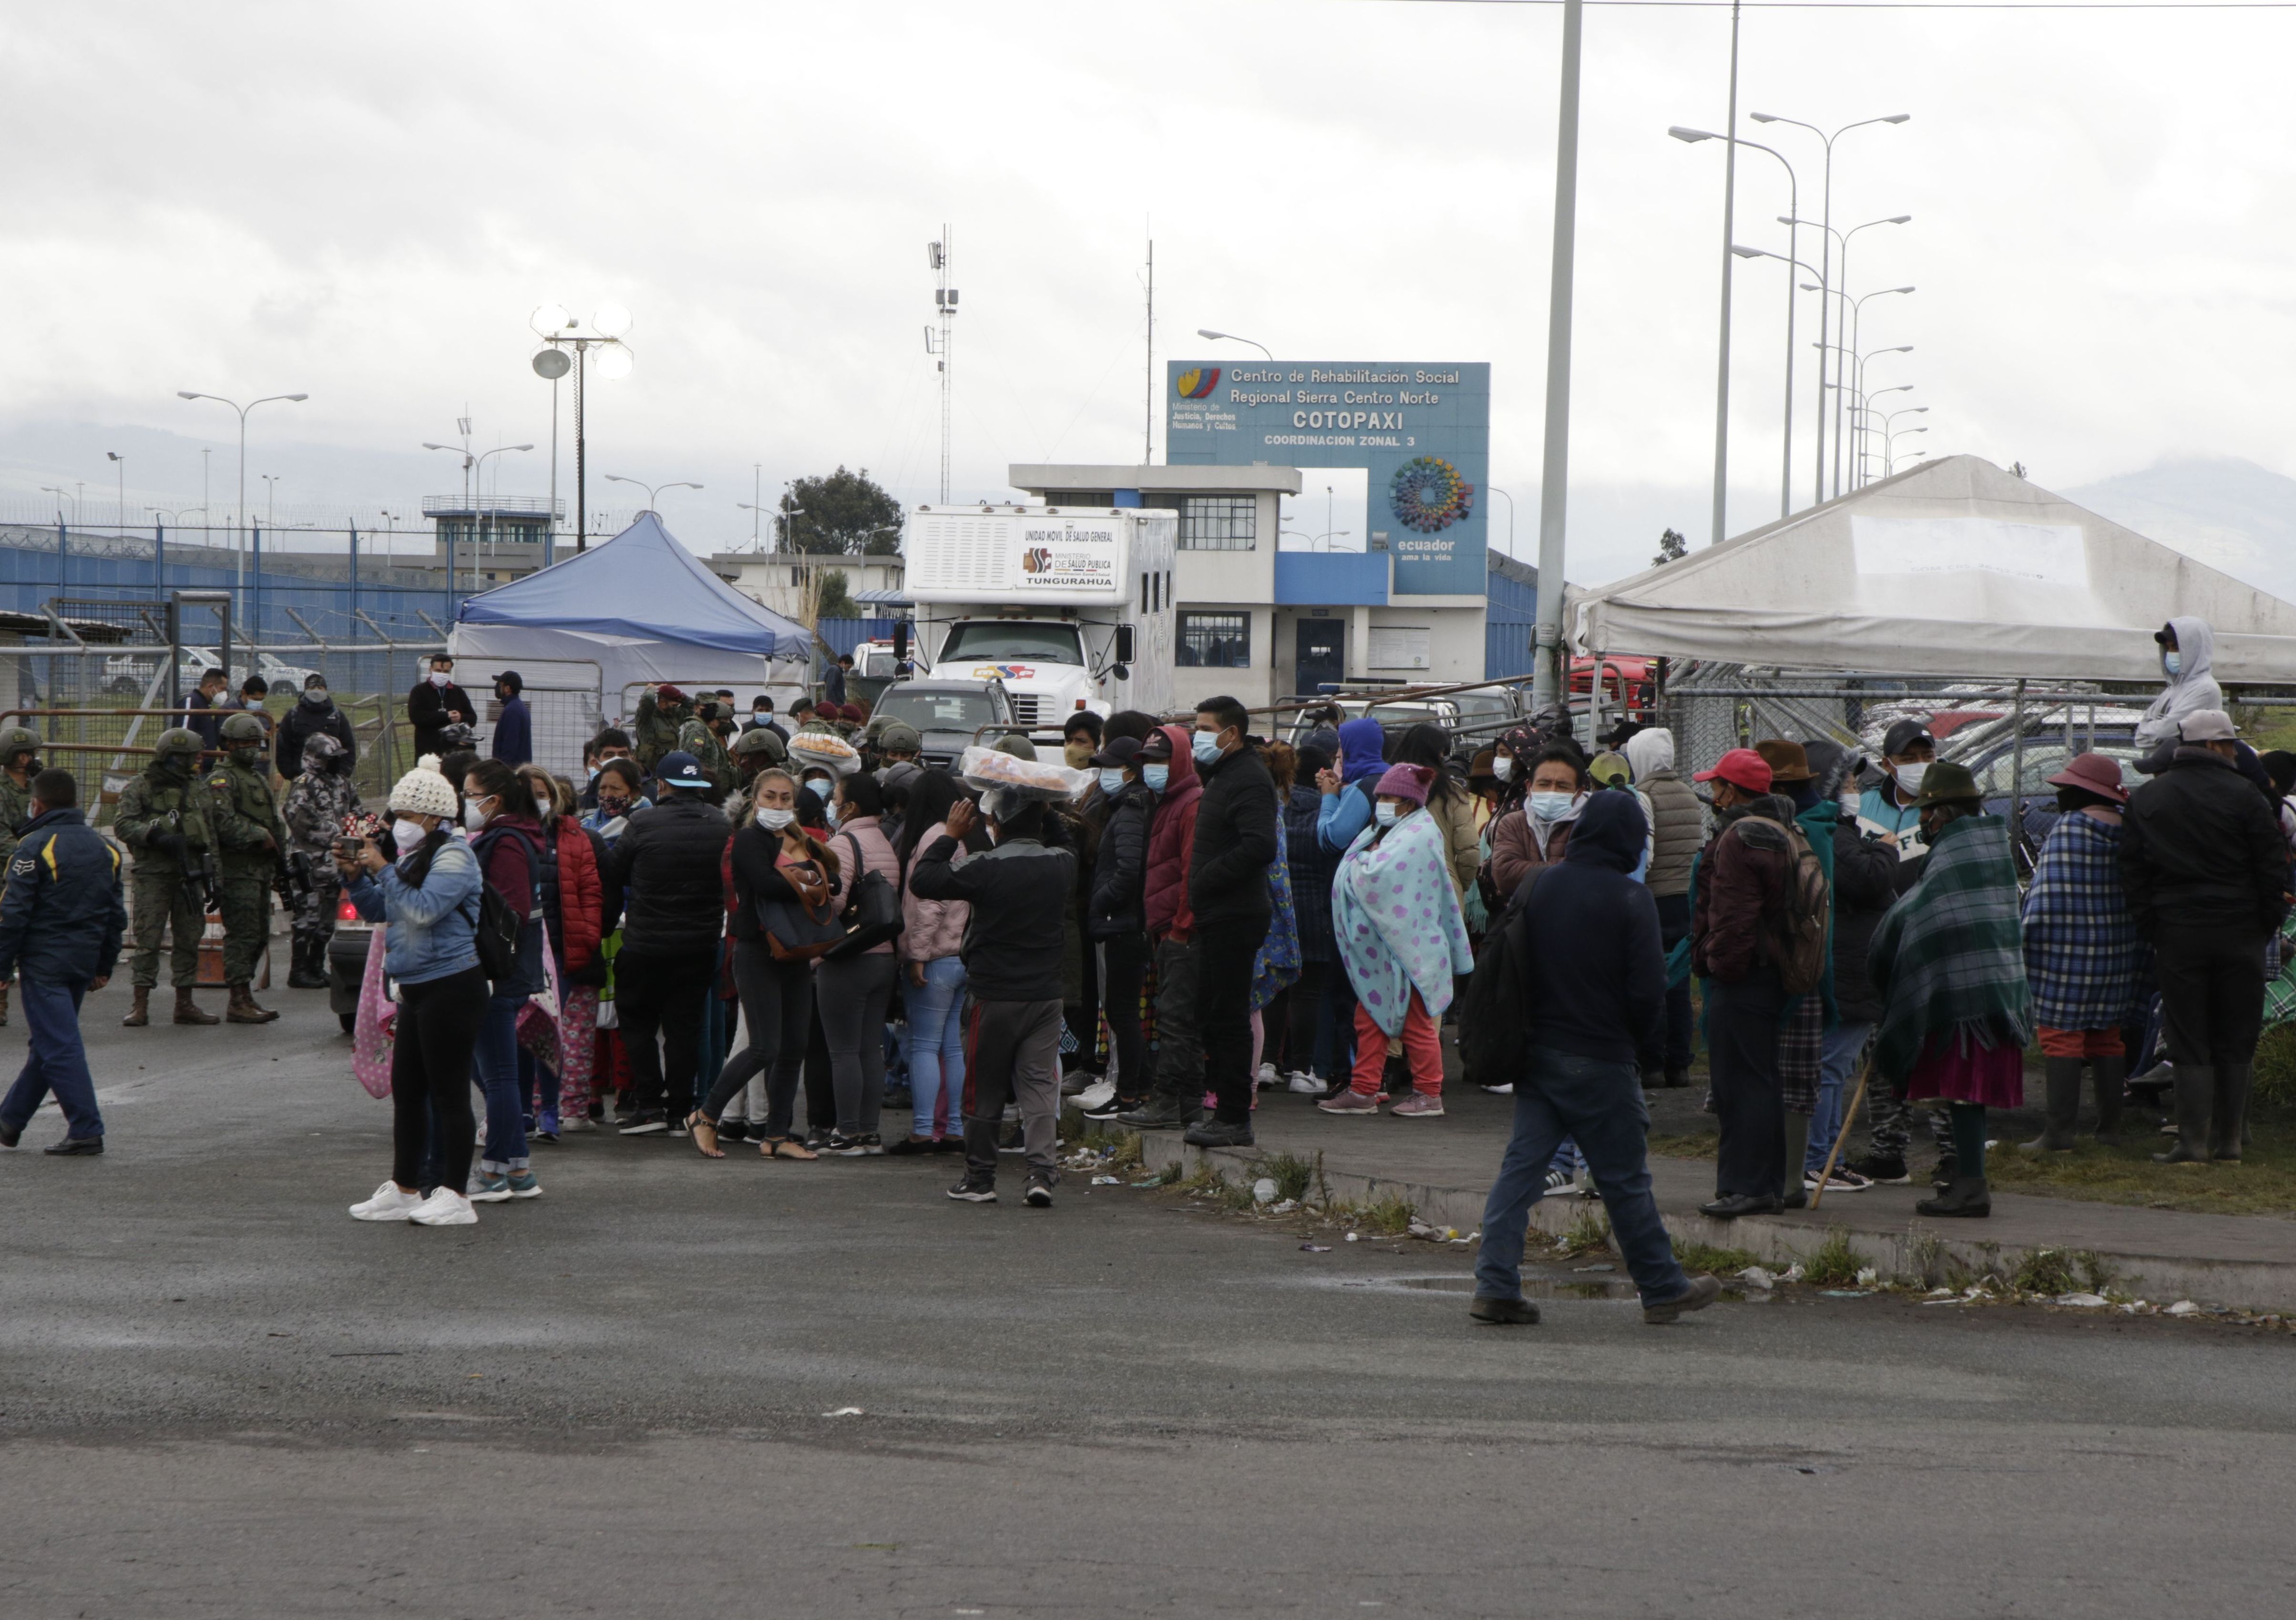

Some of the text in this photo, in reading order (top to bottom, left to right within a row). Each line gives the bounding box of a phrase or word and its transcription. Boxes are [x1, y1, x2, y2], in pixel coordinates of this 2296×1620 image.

[1231, 369, 1459, 384] Centro de Rehabilitación Social
[1230, 389, 1439, 407] Regional Sierra Centro Norte
[1172, 402, 1207, 411] Ministerio
[1205, 412, 1236, 420] Derechos
[1293, 411, 1403, 430] COTOPAXI
[1172, 420, 1203, 429] Humanos
[1265, 435, 1415, 446] COORDINACION ZONAL 3
[1025, 531, 1113, 543] UNIDAD MOVIL DE SALUD GENERAL
[1398, 539, 1455, 551] ecuador
[1068, 560, 1086, 568] SALUD
[1087, 560, 1111, 569] PUBLICA
